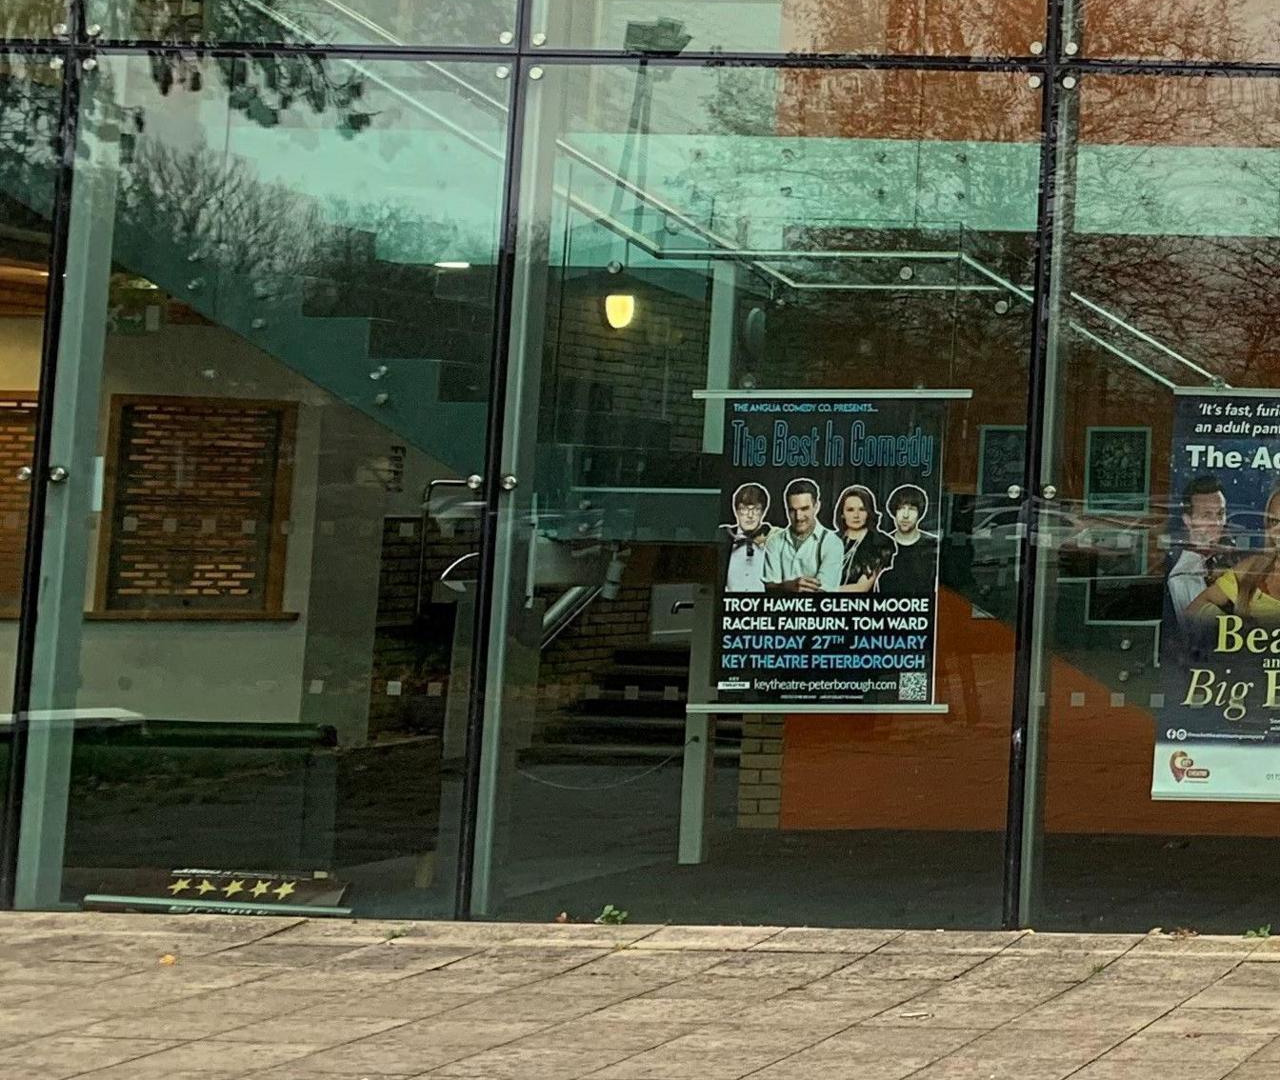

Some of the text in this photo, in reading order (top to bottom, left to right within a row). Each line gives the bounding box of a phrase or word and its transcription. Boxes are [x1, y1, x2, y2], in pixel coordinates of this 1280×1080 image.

[733, 403, 749, 412] THE
[749, 403, 781, 412] ANGLIA
[782, 403, 816, 412] COMEDY
[1223, 405, 1253, 419] fast,
[1194, 423, 1212, 434] an
[1214, 421, 1251, 435] adult
[731, 419, 934, 478] The Best In Comedy
[1185, 444, 1243, 469] The
[722, 598, 930, 613] TROY HAWKE. GLENN MOORE
[722, 616, 929, 631] RACHEL FAIRBURN. TOM WARD
[721, 634, 928, 650] SATURDAY 27TH JANUARY
[721, 654, 926, 670] KEY THEATRE PETERBOROUGH
[753, 677, 897, 692] keytheatre-peterborough.com
[1180, 667, 1255, 721] Big
